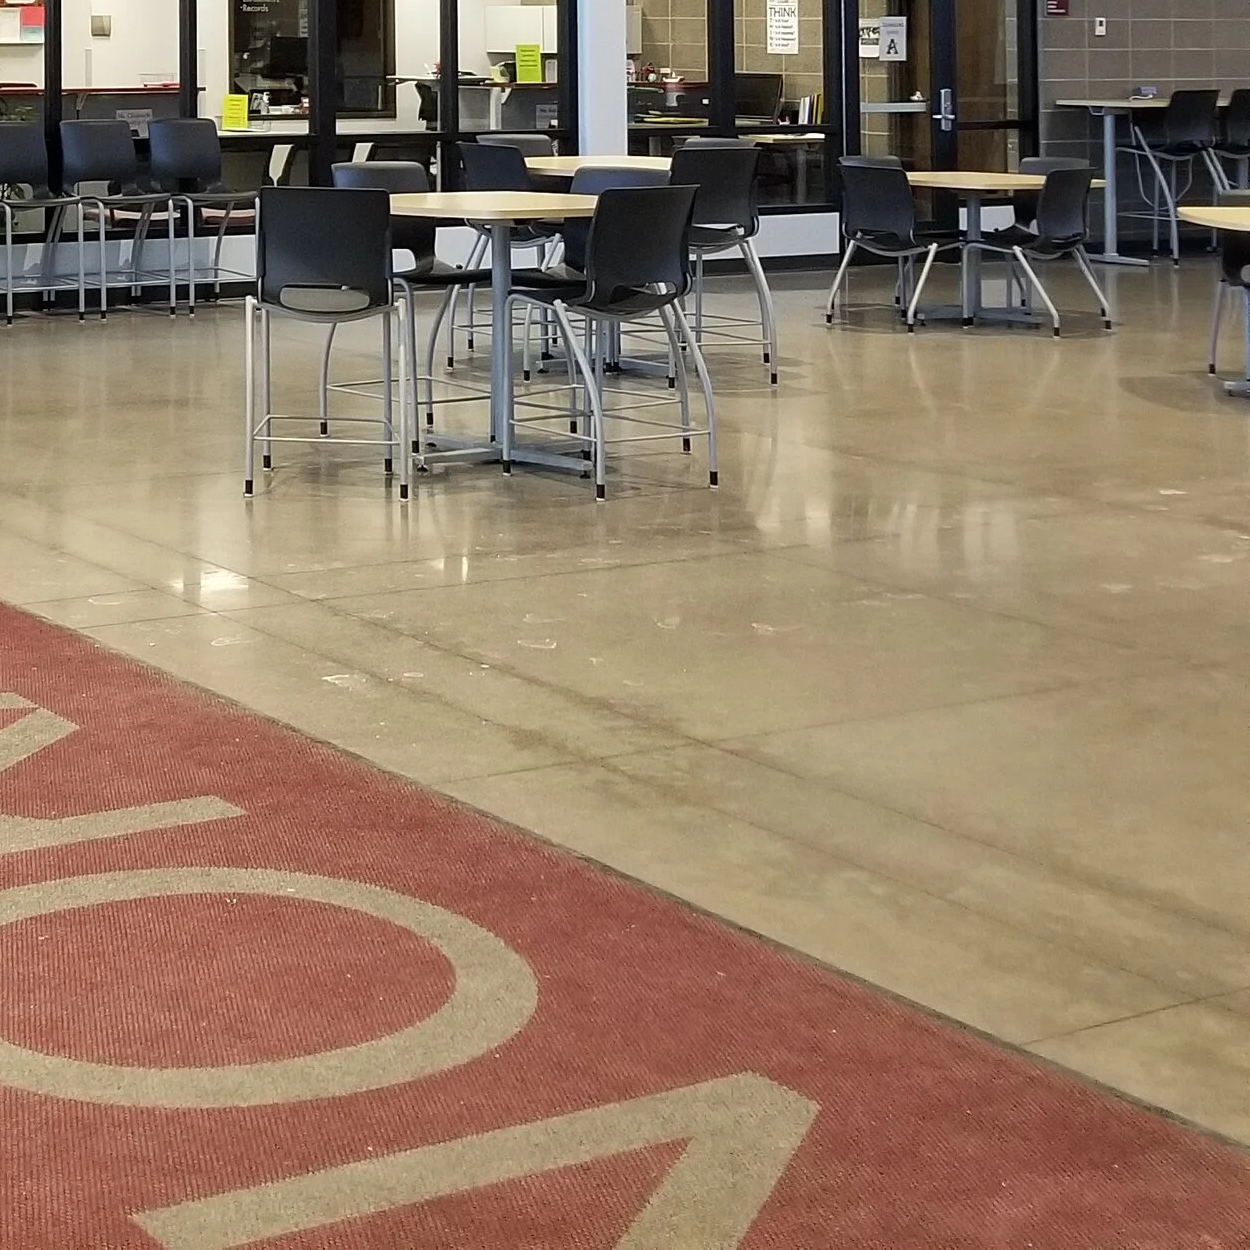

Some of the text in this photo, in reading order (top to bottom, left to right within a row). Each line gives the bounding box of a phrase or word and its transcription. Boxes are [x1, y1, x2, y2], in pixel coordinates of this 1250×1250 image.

[243, 4, 269, 12] Records
[769, 7, 796, 18] THINK
[886, 38, 899, 55] A
